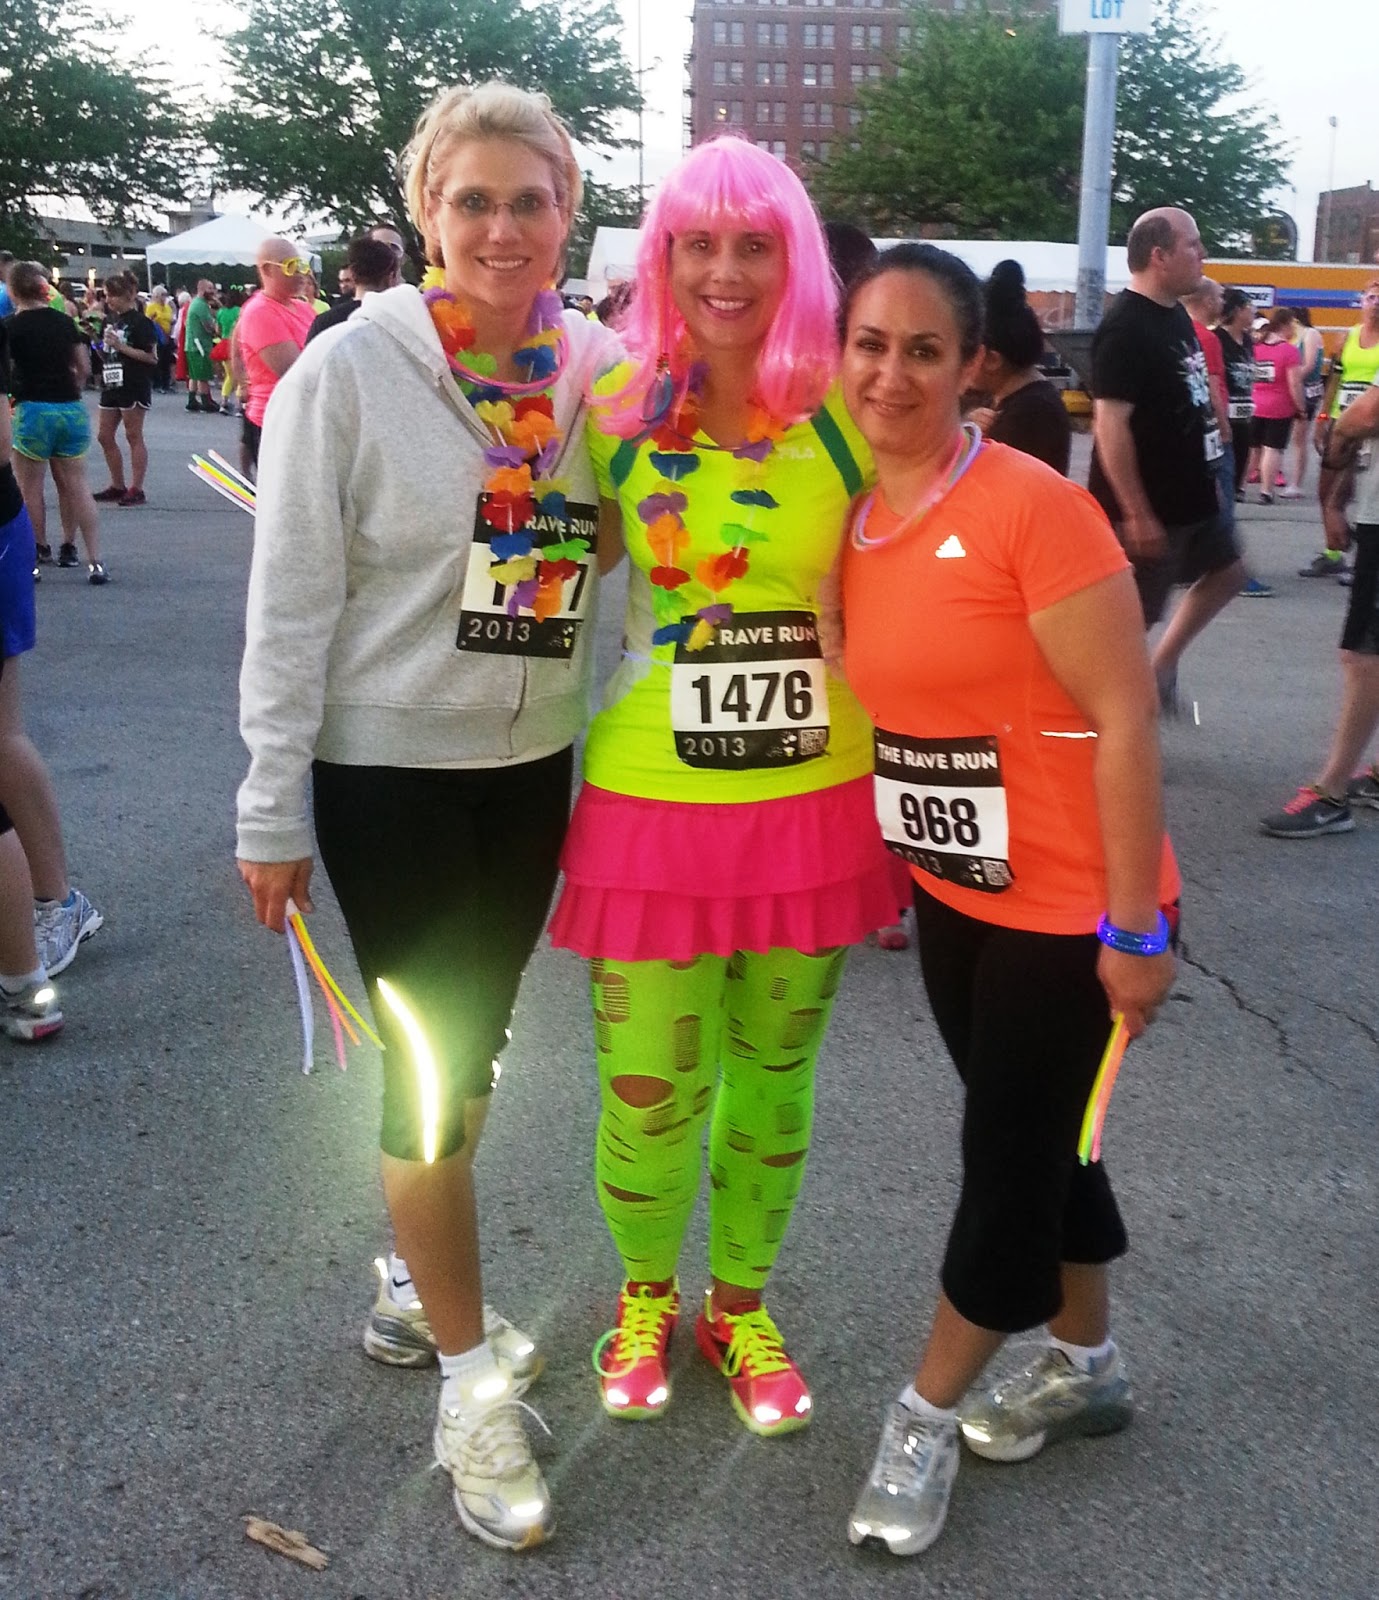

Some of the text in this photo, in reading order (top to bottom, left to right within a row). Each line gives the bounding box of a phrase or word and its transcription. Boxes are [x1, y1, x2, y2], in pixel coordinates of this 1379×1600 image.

[1091, 0, 1124, 18] LOT
[526, 515, 598, 537] RAVE RUN
[489, 559, 588, 612] 17
[468, 618, 531, 642] 2013
[720, 628, 774, 646] RAVE
[780, 626, 816, 642] RUN
[691, 670, 814, 724] 1476
[683, 737, 746, 757] 2013
[877, 742, 998, 770] THE RAVE RUN
[899, 793, 982, 848] 968
